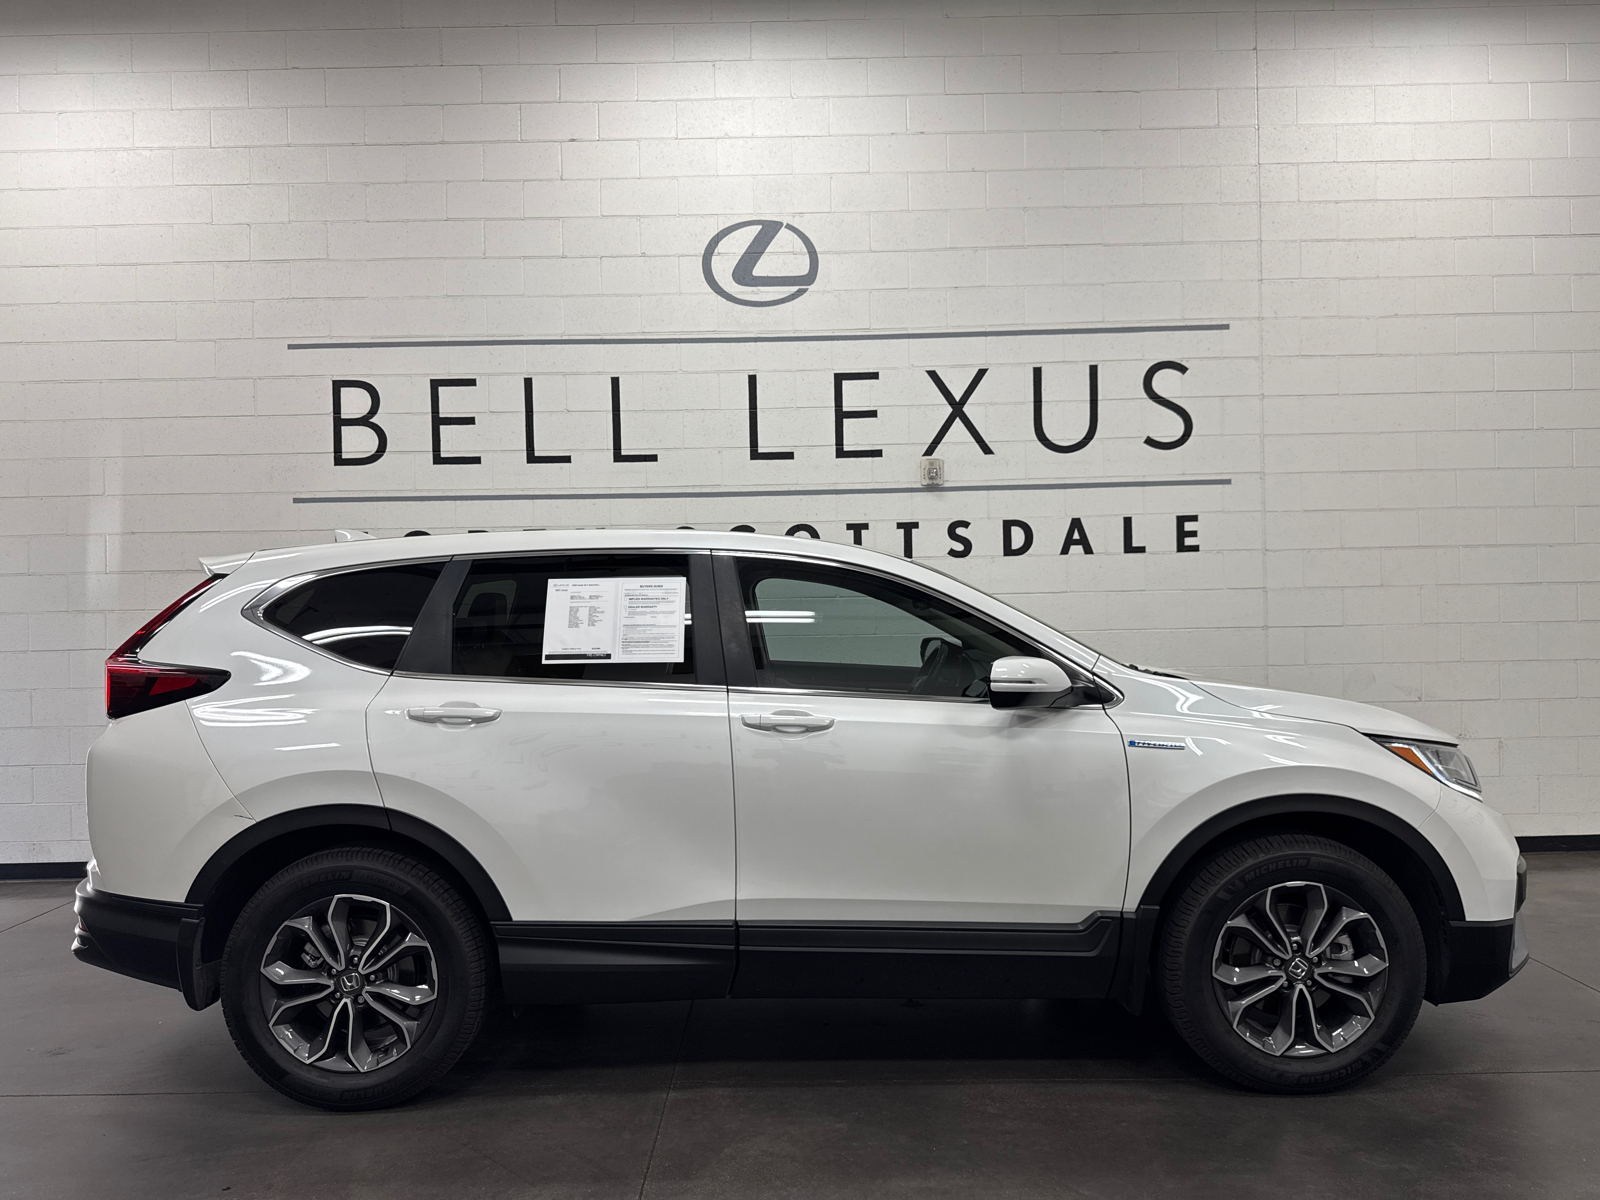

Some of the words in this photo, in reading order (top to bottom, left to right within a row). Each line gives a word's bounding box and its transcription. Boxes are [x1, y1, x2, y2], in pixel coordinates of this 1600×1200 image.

[331, 377, 658, 467] BELL
[747, 360, 1194, 461] LEXUS
[676, 514, 1200, 560] TTSDALE
[1243, 858, 1309, 883] MICHELIN
